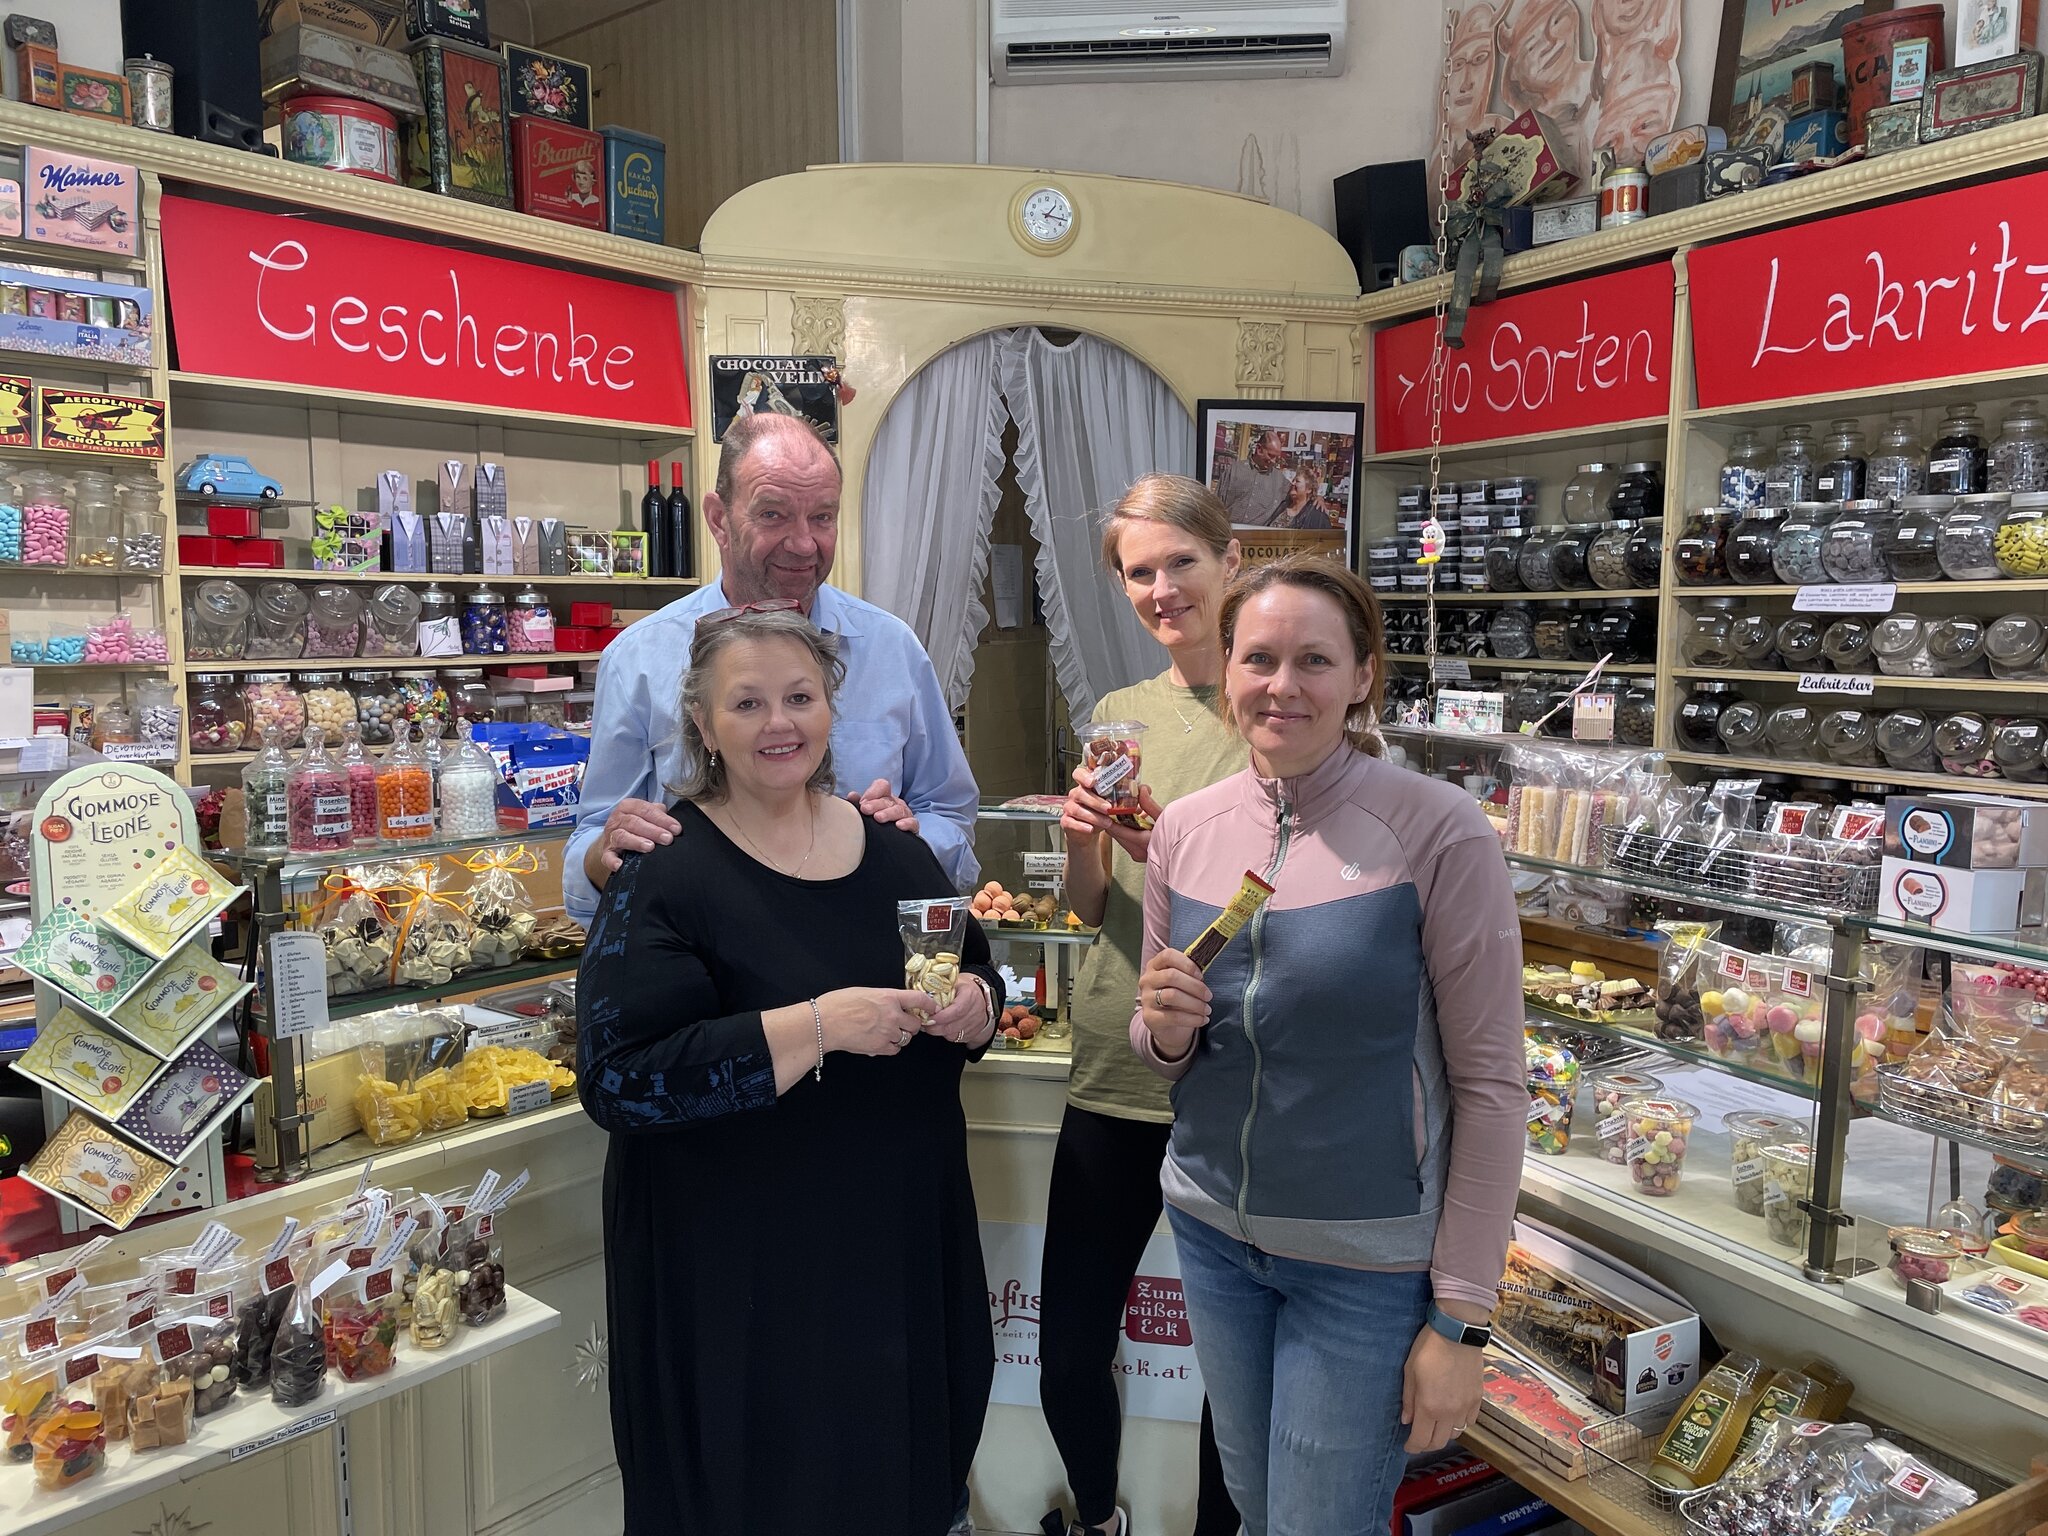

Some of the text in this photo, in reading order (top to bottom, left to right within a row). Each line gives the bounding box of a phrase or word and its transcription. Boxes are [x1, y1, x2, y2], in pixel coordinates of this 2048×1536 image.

[532, 138, 596, 168] Brandt
[40, 164, 125, 192] Manner
[249, 240, 634, 390] Geschenke
[78, 332, 99, 341] ITALIA
[716, 359, 808, 371] CHOCOLAT
[1485, 300, 1658, 413] Sorten
[64, 396, 145, 412] AEROPLANE
[48, 438, 159, 456] CALL FIREMEN 112
[66, 435, 143, 448] CHOCOLATE
[1801, 676, 1873, 693] Lakritzbar
[104, 744, 175, 755] DEVOTIONALIEN
[544, 776, 576, 791] POWE
[68, 793, 160, 821] GOMMOSE
[269, 796, 286, 804] Minz
[90, 815, 152, 845] LEONE
[139, 873, 191, 913] GOMMOSE LEONE
[69, 932, 121, 974] GOMMOSE LEONE
[145, 970, 198, 1012] GOMMOSE LEONE
[73, 1034, 126, 1075] GOMMOSE LEONE
[150, 1081, 182, 1115] GOMMOSE
[82, 1142, 136, 1183] GOMMOSE LEONE
[1138, 1282, 1183, 1301] Zum
[1497, 1281, 1593, 1310] ILWAY MILKCHOCOLATE
[1128, 1301, 1189, 1320] süßen
[1002, 1329, 1024, 1339] seit
[1141, 1318, 1179, 1337] Eck
[1569, 1393, 1612, 1420] CHOCOLA
[239, 1443, 256, 1453] Bitte
[277, 1423, 310, 1439] Packungen
[311, 1414, 332, 1426] öffnen
[1682, 1420, 1711, 1437] INGWER
[1682, 1426, 1704, 1438] SIRUP
[1500, 1499, 1550, 1524] CHO-KA-KOLA
